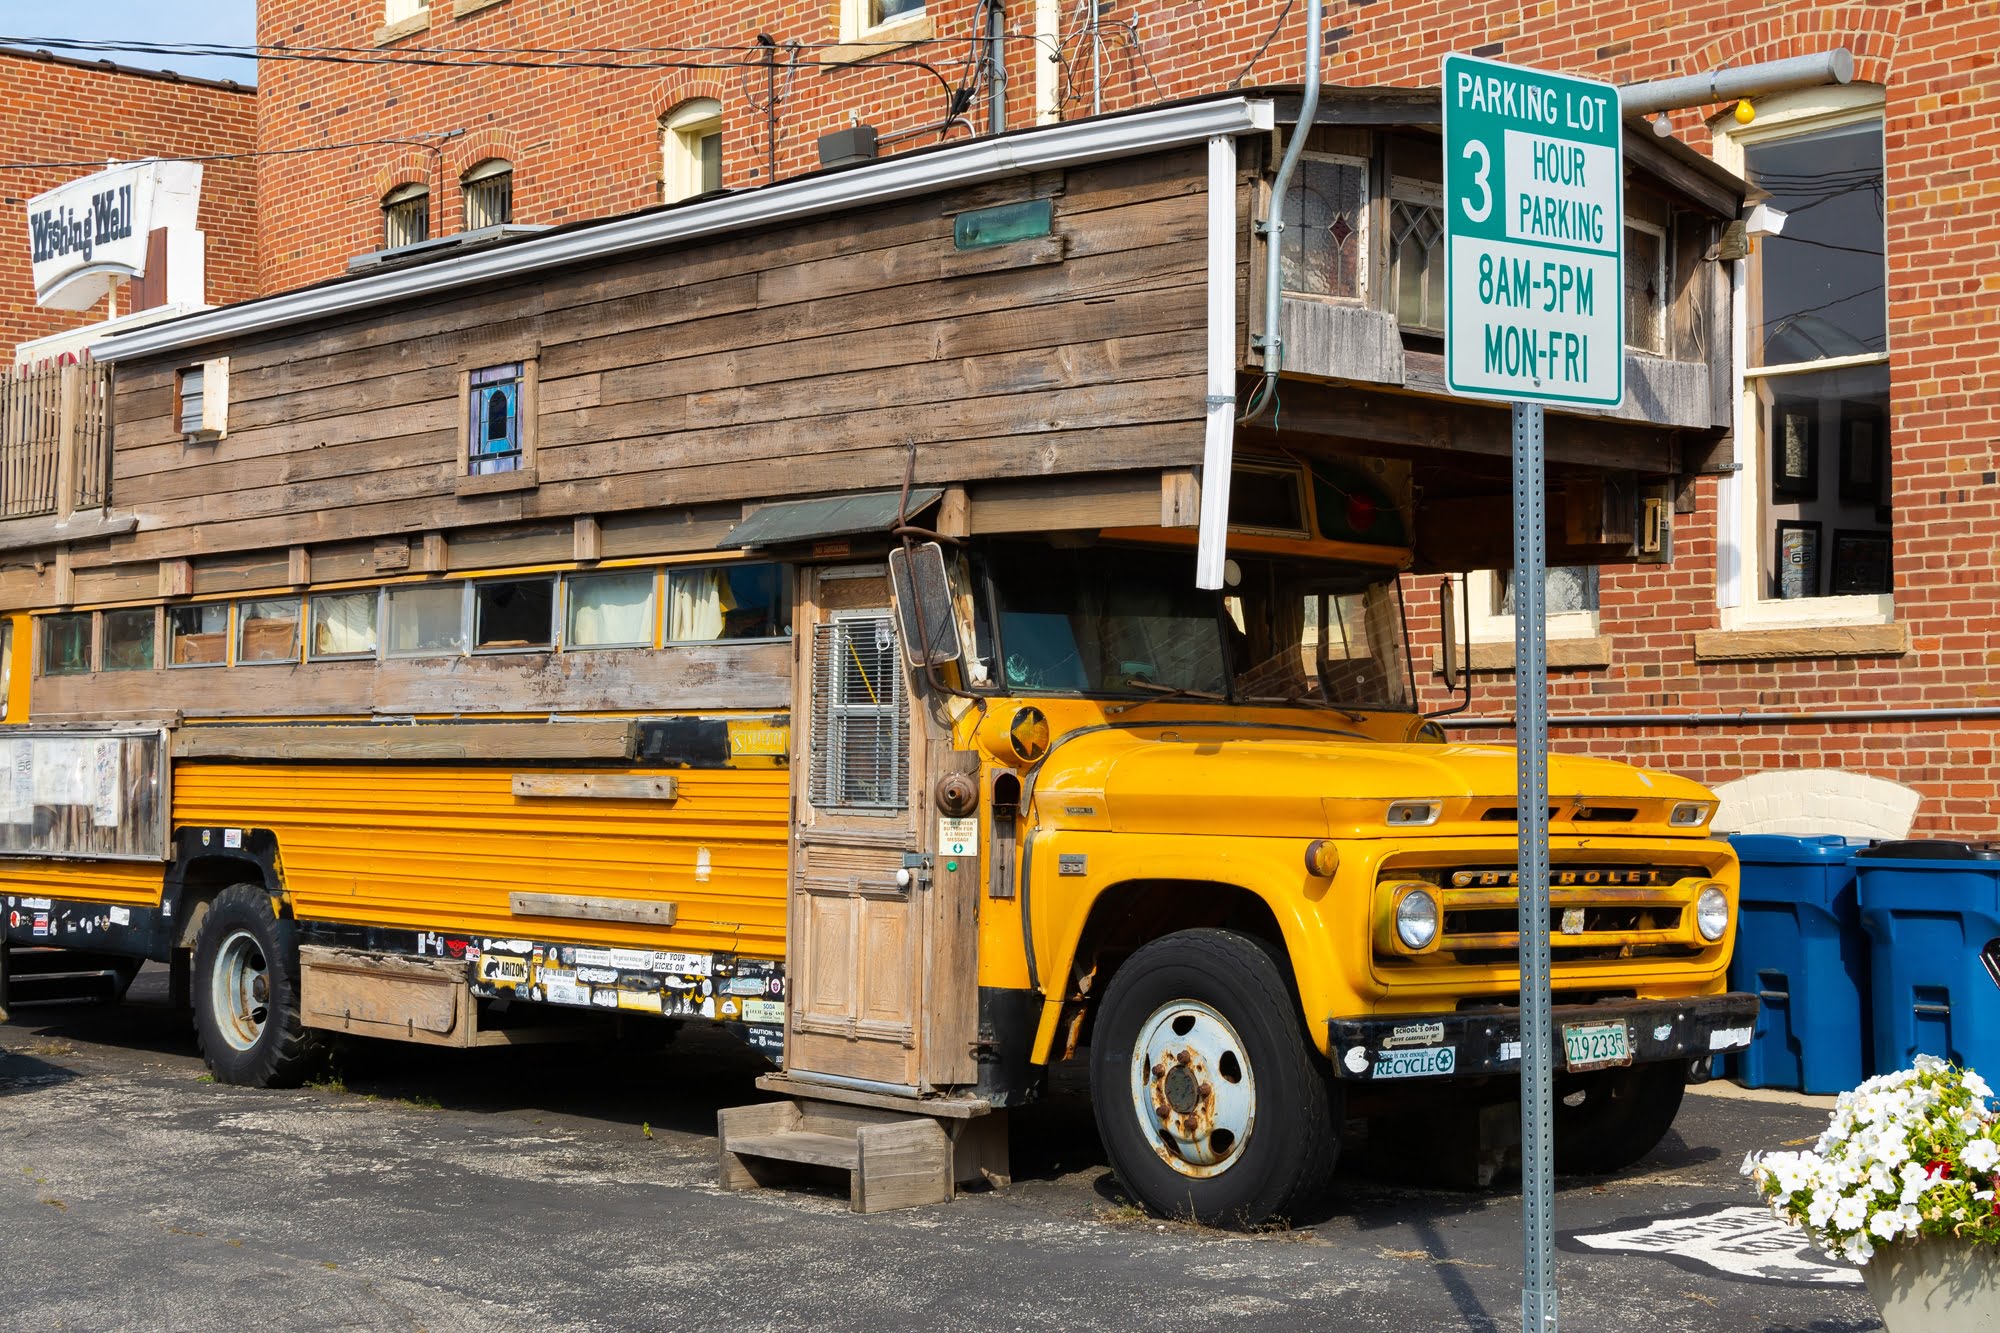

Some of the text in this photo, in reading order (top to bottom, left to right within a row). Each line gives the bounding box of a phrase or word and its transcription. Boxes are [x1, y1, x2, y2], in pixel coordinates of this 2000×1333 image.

[1458, 72, 1607, 133] PARKING LOT
[1461, 139, 1493, 223] 3
[1533, 140, 1586, 188] HOUR
[31, 184, 132, 264] Wishing Well
[1519, 193, 1603, 244] PARKING
[1478, 252, 1594, 317] 8AM-5PM
[1485, 323, 1588, 384] MON-FRI
[1451, 870, 1660, 887] CHEROLET
[654, 952, 686, 961] GET YOUR
[654, 961, 685, 972] KICKS ON
[750, 1028, 774, 1036] CAUTION:
[1396, 1026, 1424, 1034] SCHOOL'S
[1567, 1036, 1590, 1061] 219
[1592, 1033, 1617, 1059] 233
[1376, 1058, 1434, 1075] RECYCLE
